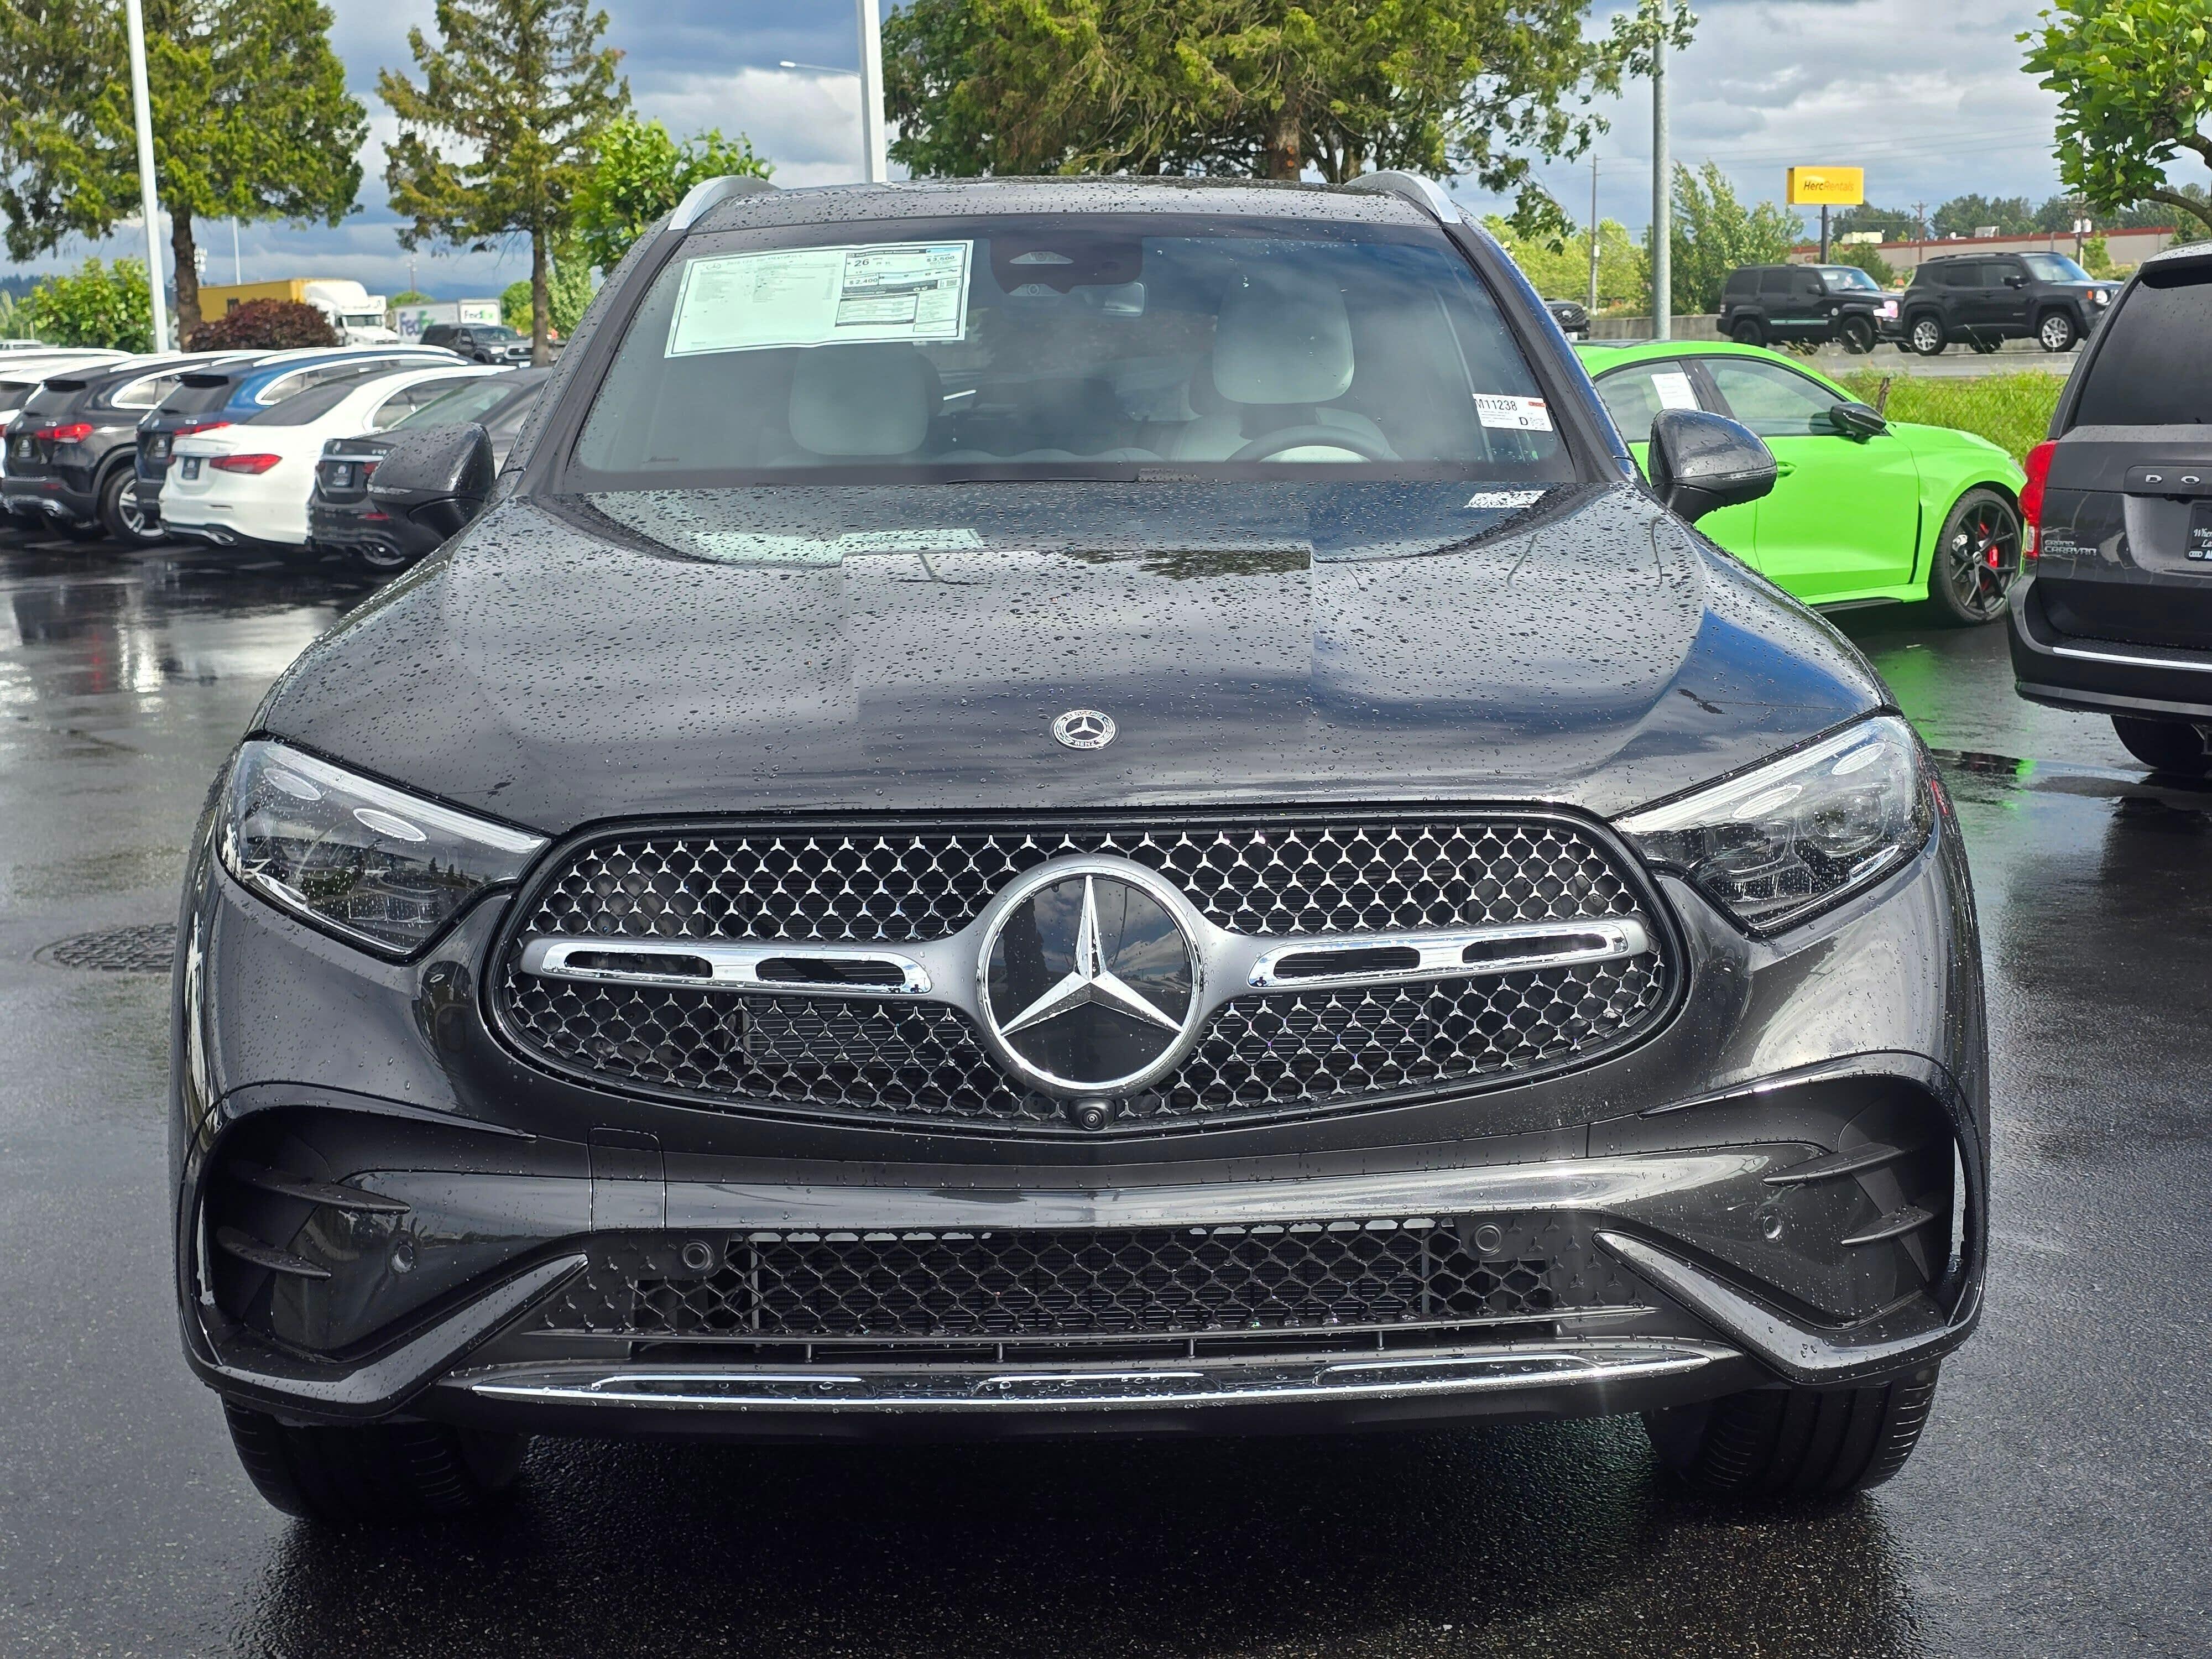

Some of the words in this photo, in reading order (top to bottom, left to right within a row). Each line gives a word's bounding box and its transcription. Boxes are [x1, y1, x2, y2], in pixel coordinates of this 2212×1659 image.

[1803, 181, 1854, 191] HercRentals
[854, 258, 869, 267] 26
[1519, 416, 1528, 426] D
[2044, 546, 2097, 556] CARAVAN
